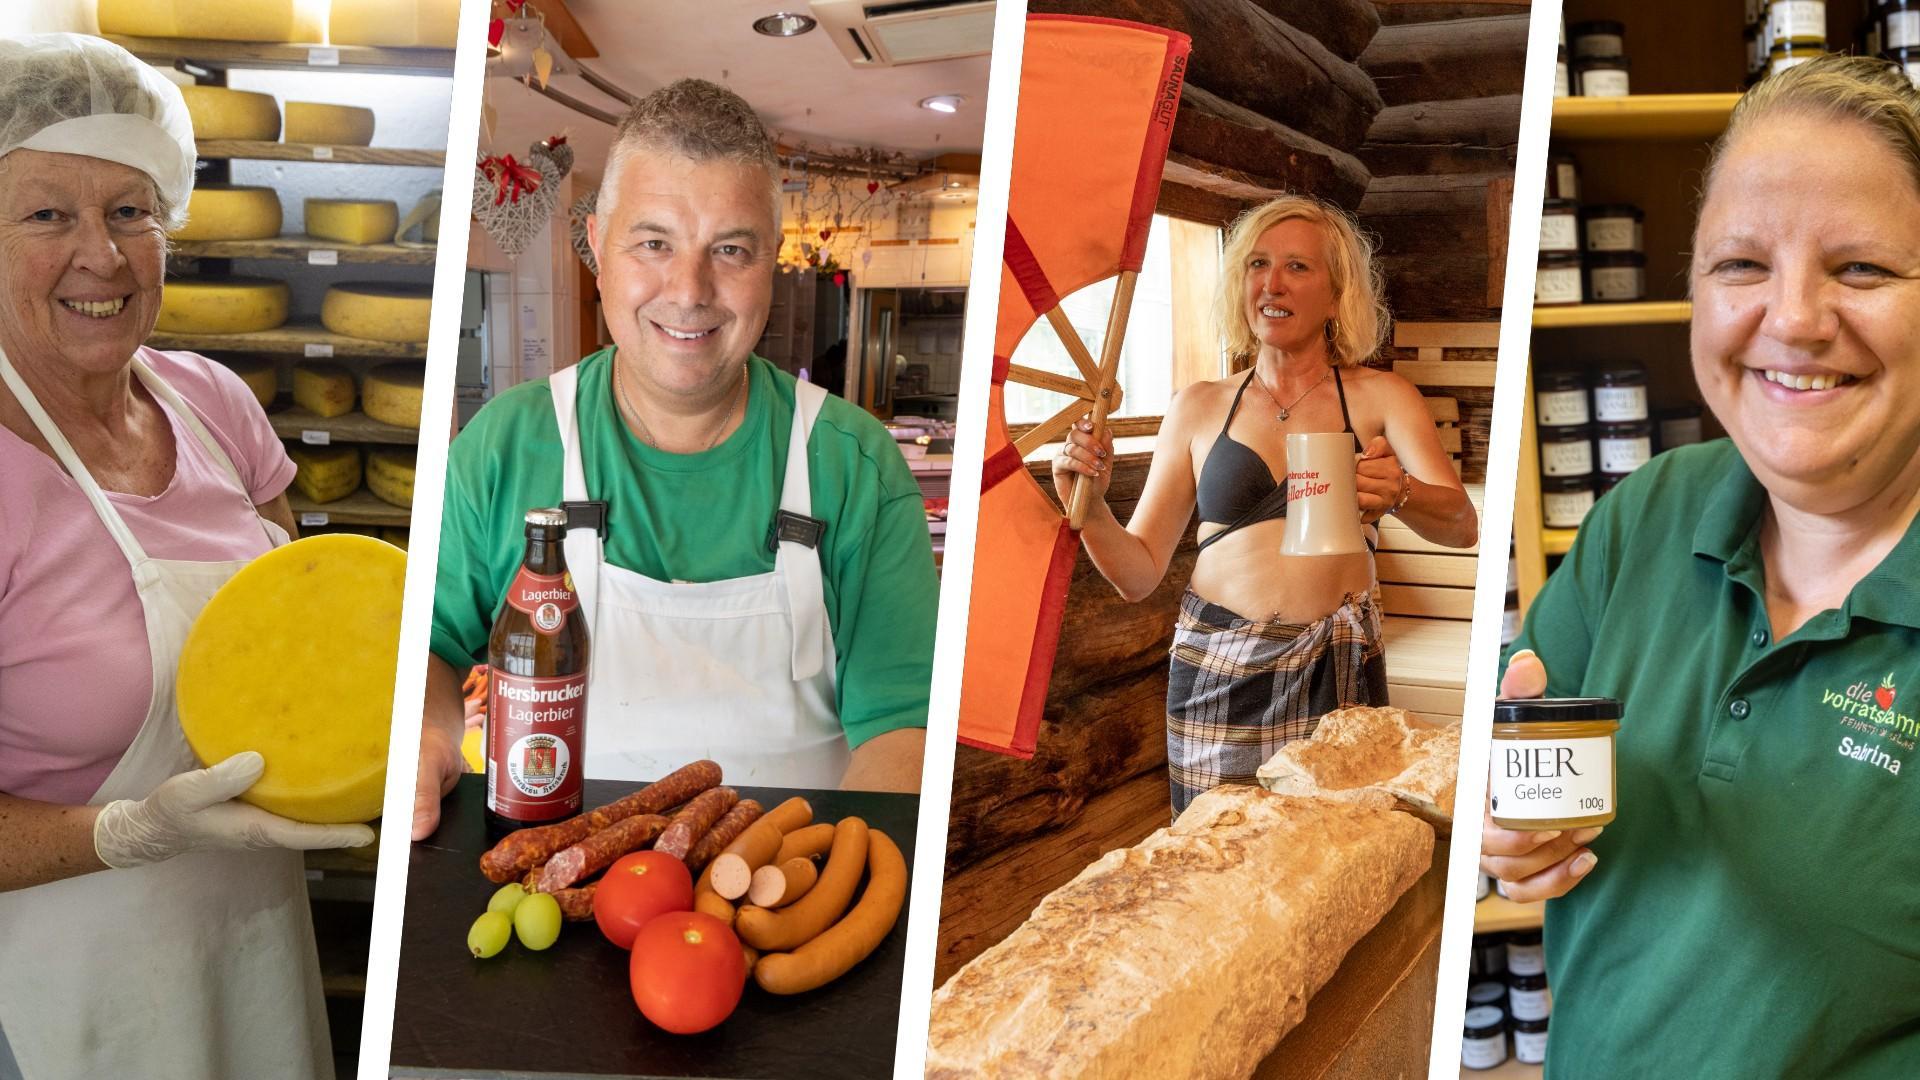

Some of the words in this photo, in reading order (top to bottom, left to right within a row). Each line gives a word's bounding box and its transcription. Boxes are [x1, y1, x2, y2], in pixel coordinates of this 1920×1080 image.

[1159, 56, 1185, 129] SAUNAGUT
[522, 588, 571, 603] Lagerbier
[498, 679, 585, 702] Hersbrucker
[1846, 681, 1873, 702] die
[508, 704, 575, 725] Lagerbier
[1505, 747, 1584, 778] BIER
[1838, 737, 1901, 775] Sabrina
[1514, 784, 1563, 800] Gelee
[1578, 796, 1604, 810] 100g
